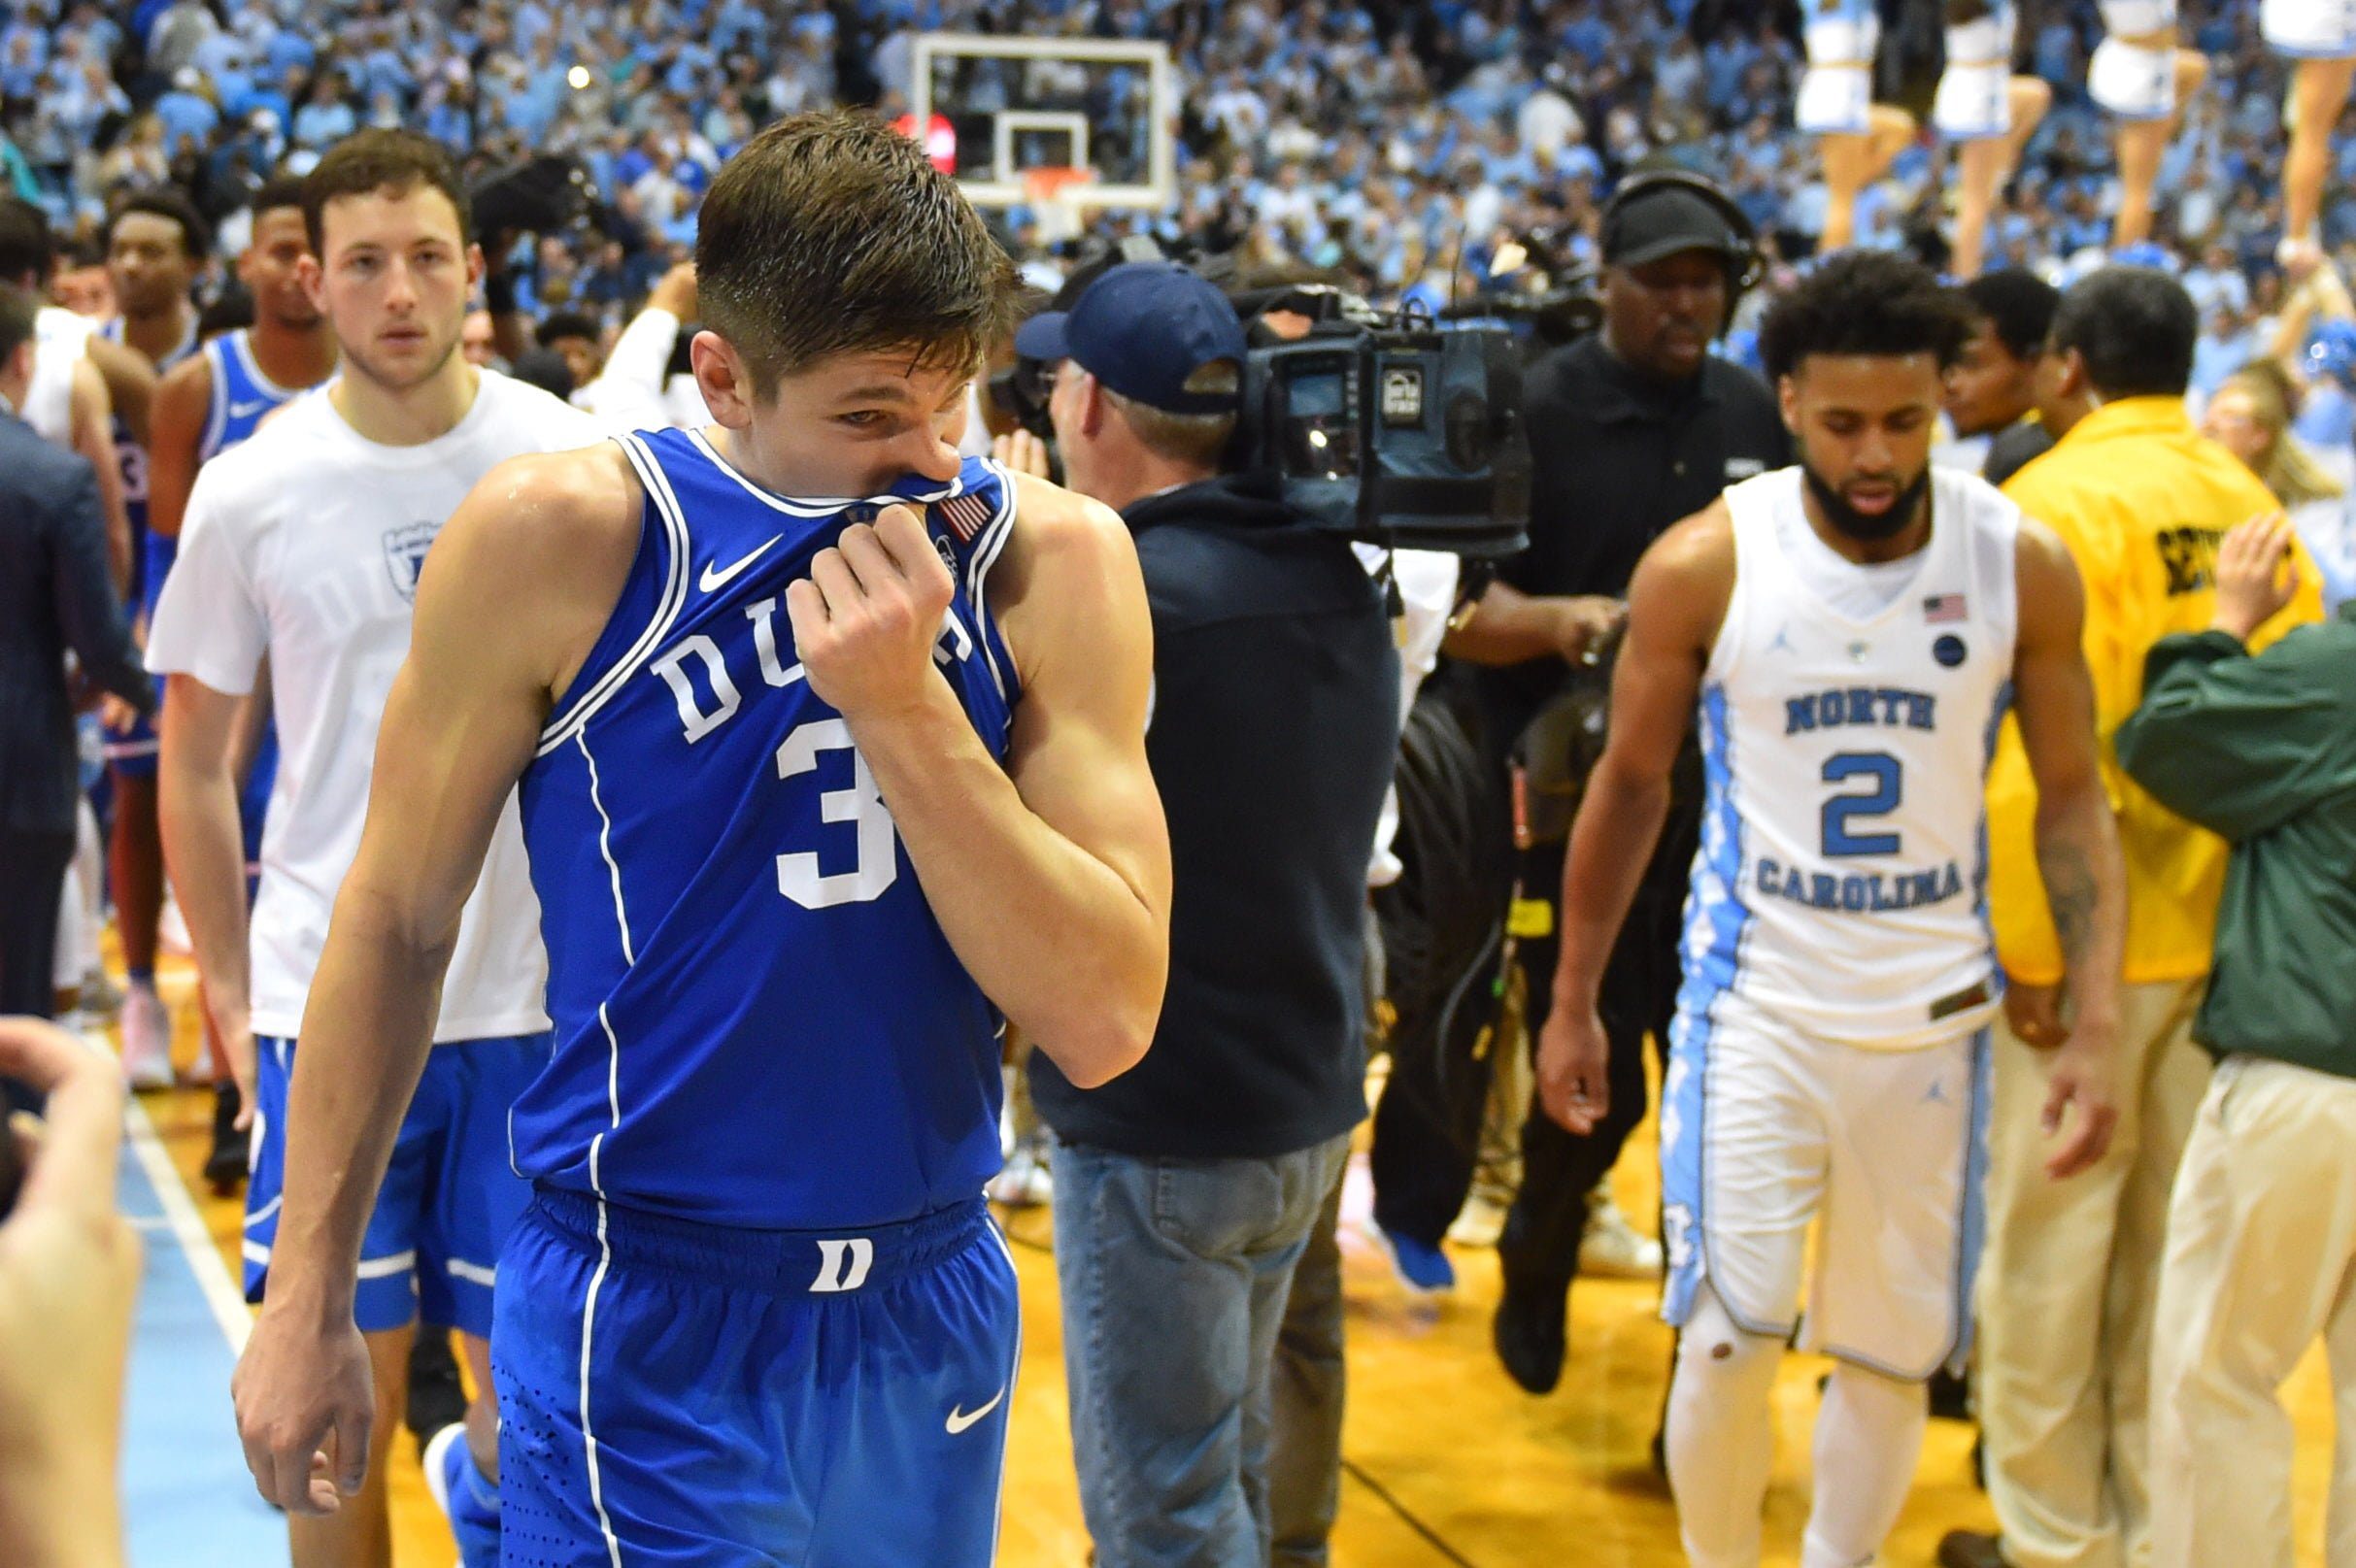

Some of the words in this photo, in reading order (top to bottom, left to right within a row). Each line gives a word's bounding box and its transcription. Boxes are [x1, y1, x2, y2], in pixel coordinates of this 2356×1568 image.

[1785, 687, 1935, 735] NORTH
[777, 717, 897, 910] 3
[1821, 751, 1902, 857] 2
[1757, 857, 1962, 912] CAROLINA
